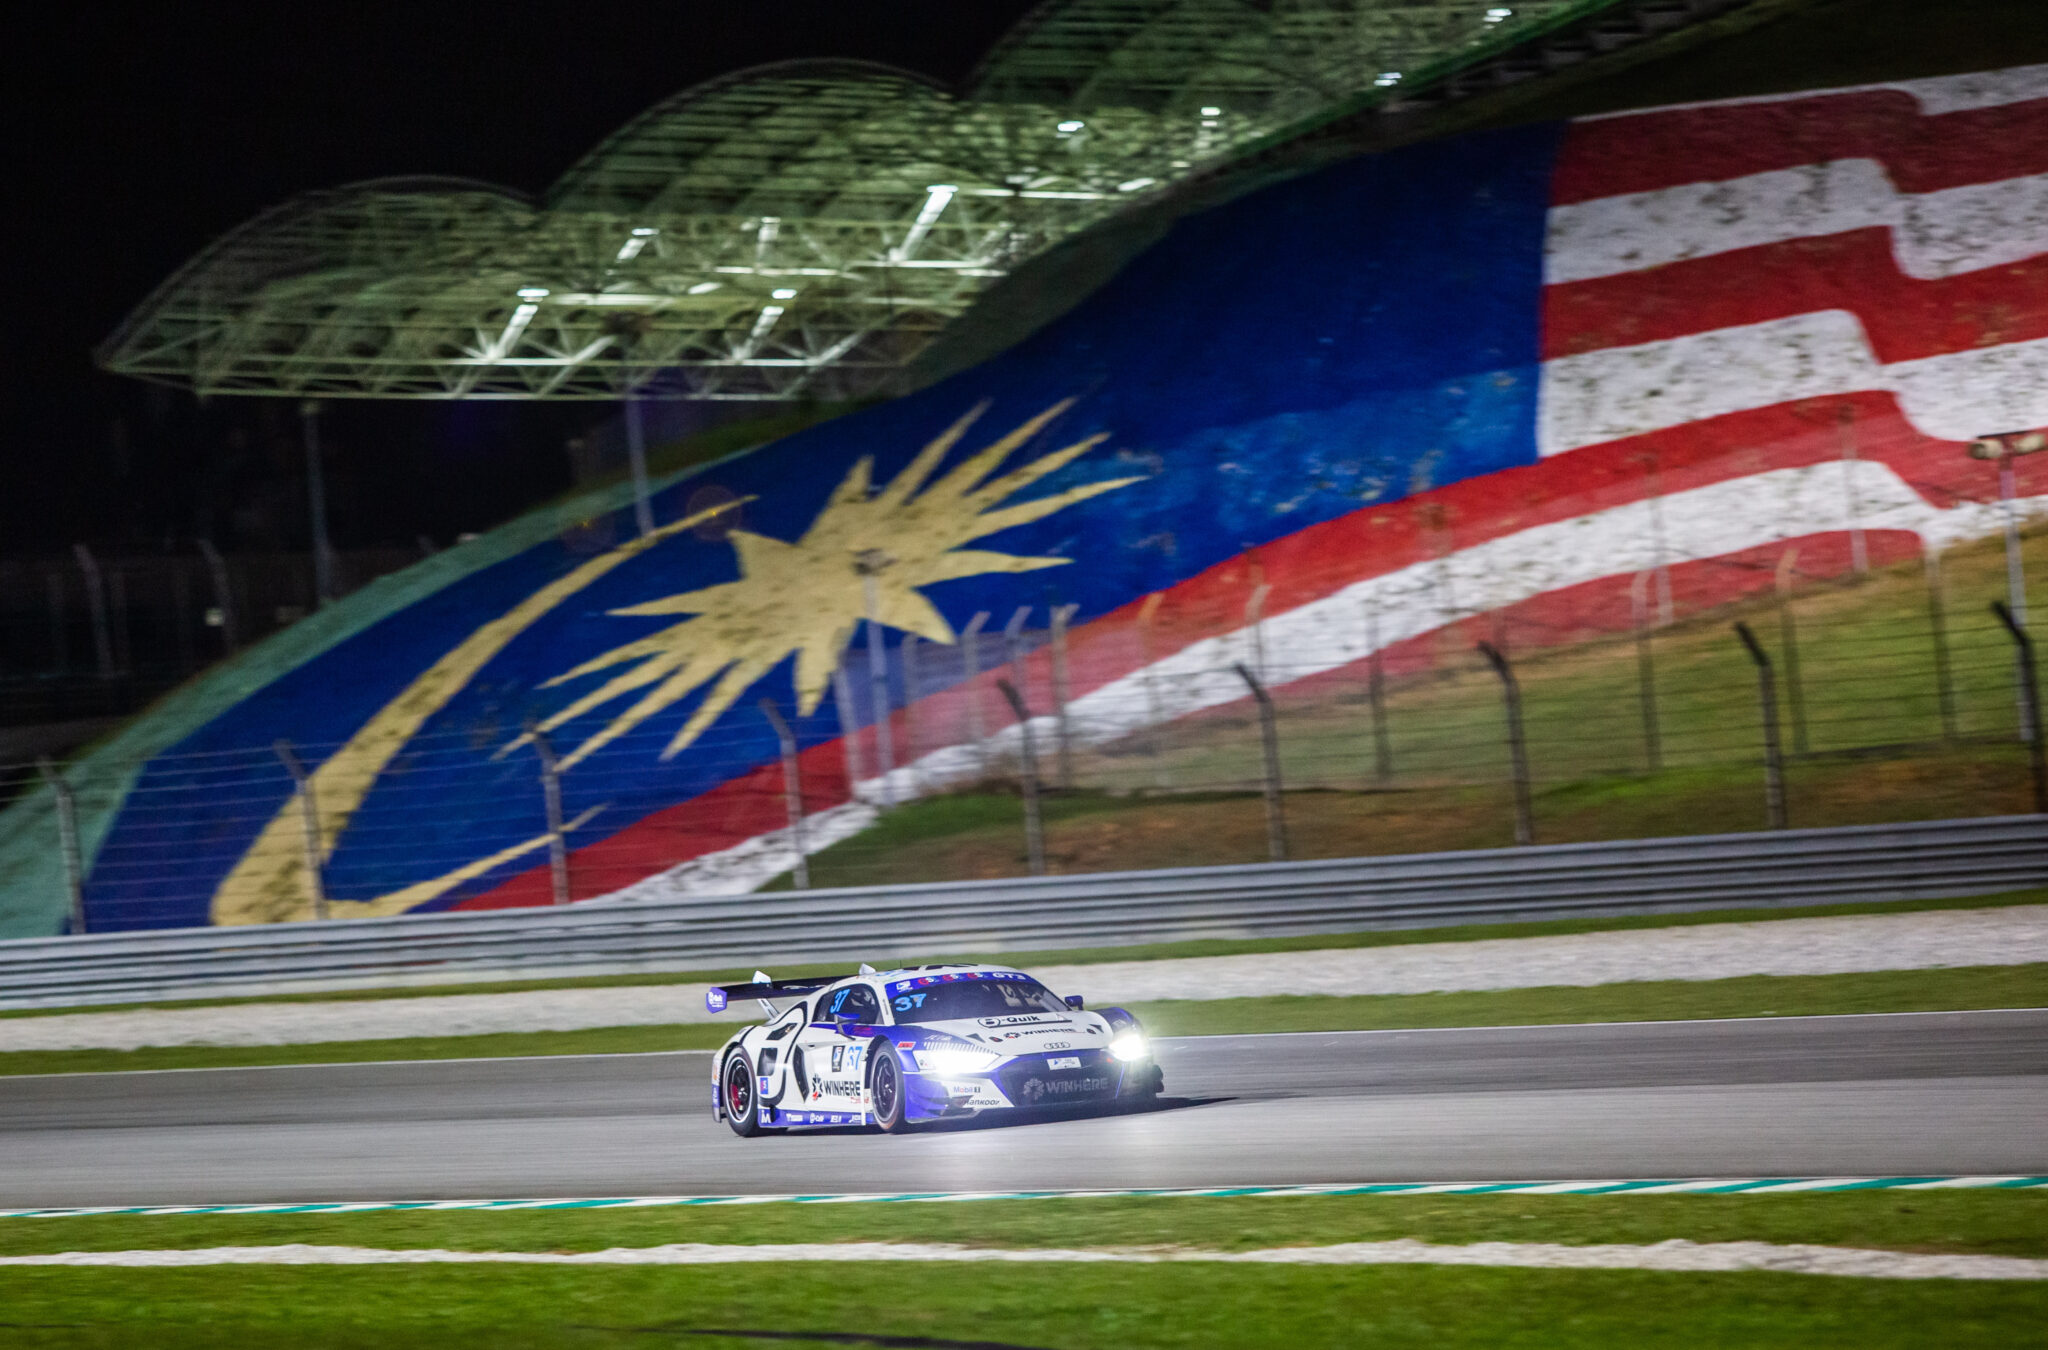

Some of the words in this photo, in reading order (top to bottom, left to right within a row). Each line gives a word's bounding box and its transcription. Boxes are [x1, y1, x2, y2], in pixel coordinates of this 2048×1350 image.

[830, 988, 851, 1014] 37
[894, 993, 927, 1012] 37
[847, 1046, 863, 1071] 37
[823, 1080, 861, 1097] WINHERE
[1046, 1078, 1108, 1094] WINHERE
